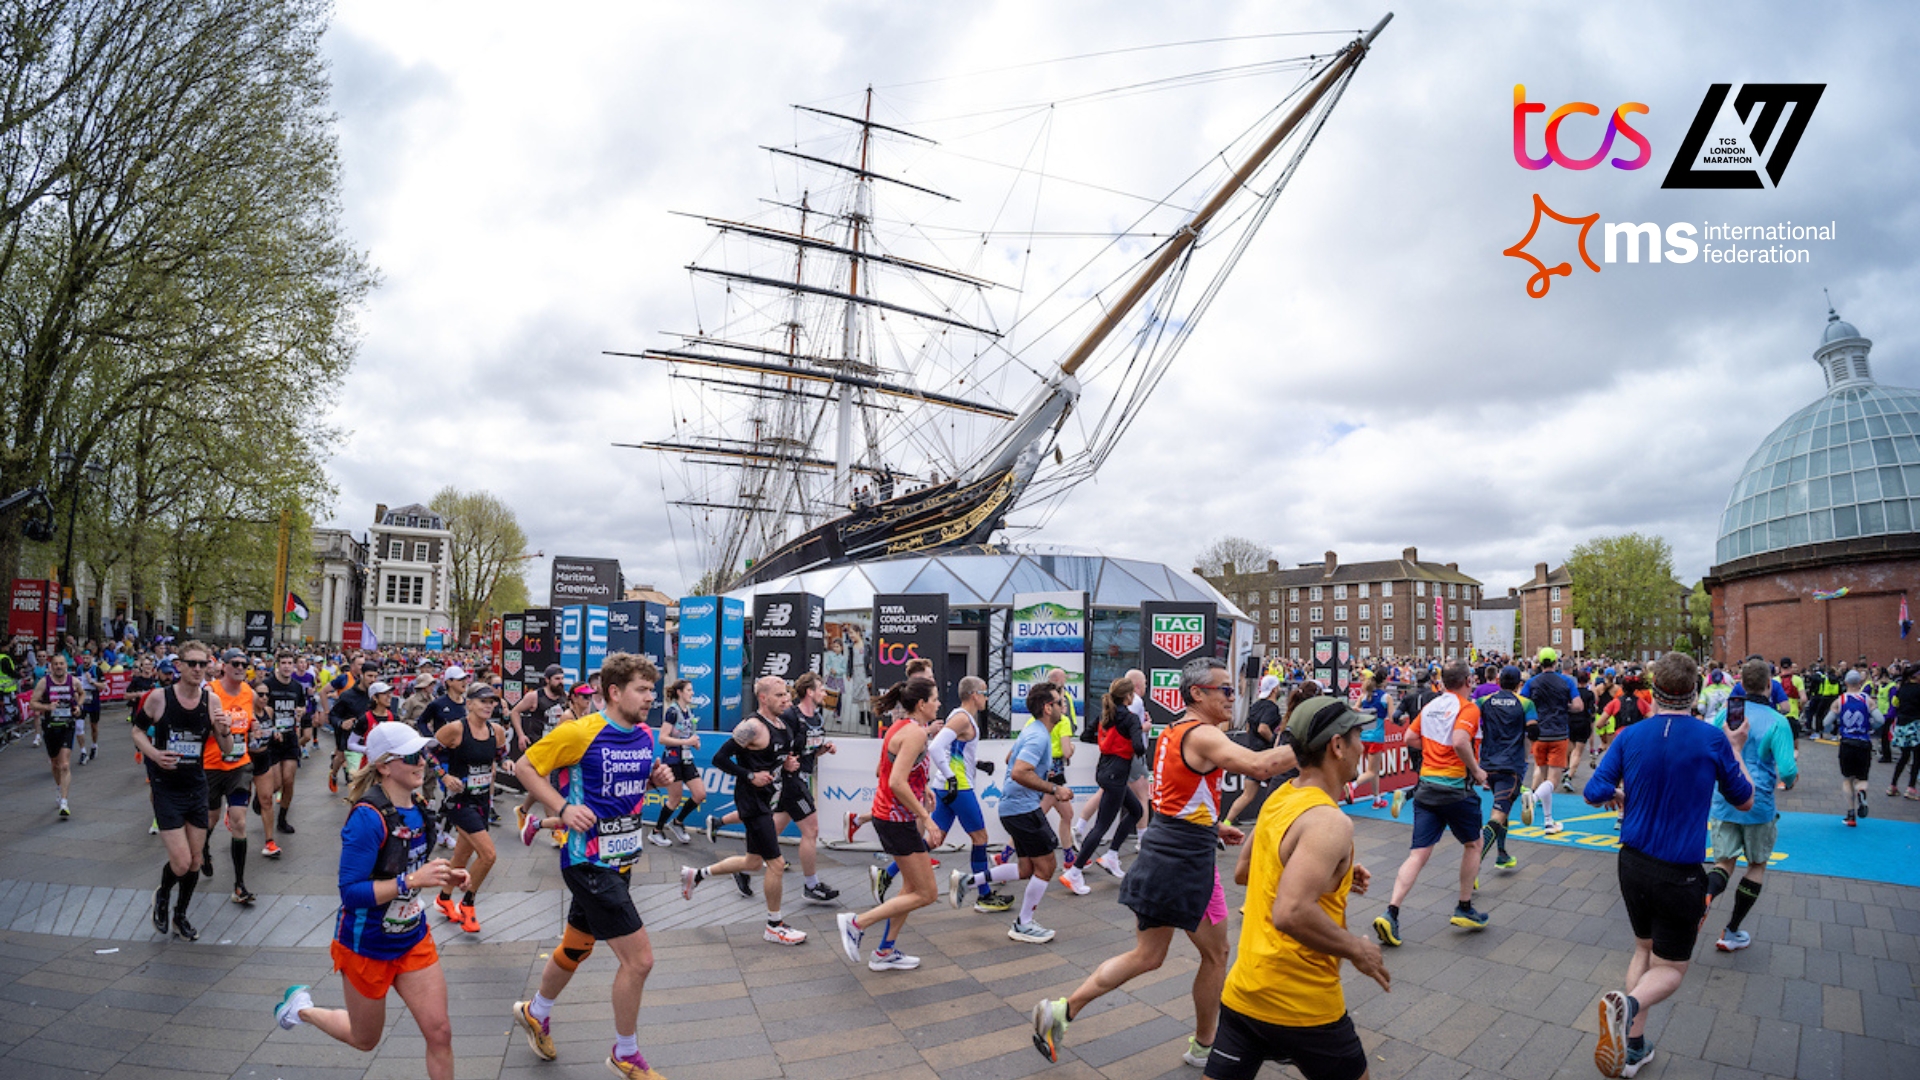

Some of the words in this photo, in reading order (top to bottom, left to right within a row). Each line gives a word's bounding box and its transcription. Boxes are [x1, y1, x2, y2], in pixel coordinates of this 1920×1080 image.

[556, 564, 585, 572] Welcome
[556, 572, 596, 583] Maritime
[13, 590, 42, 598] LONDON
[555, 582, 609, 595] Greenwich
[12, 598, 41, 612] PRIDE
[879, 615, 939, 624] CONSULTANCY
[1157, 618, 1200, 631] TAG
[879, 625, 917, 634] SERVICES
[1019, 622, 1078, 636] BUXTON
[1154, 632, 1202, 656] HEUER
[1154, 672, 1181, 686] TA
[601, 747, 653, 761] Pancreatic
[602, 760, 641, 773] Cancer
[602, 772, 613, 785] U
[601, 784, 612, 797] K
[614, 780, 645, 798] CHARL
